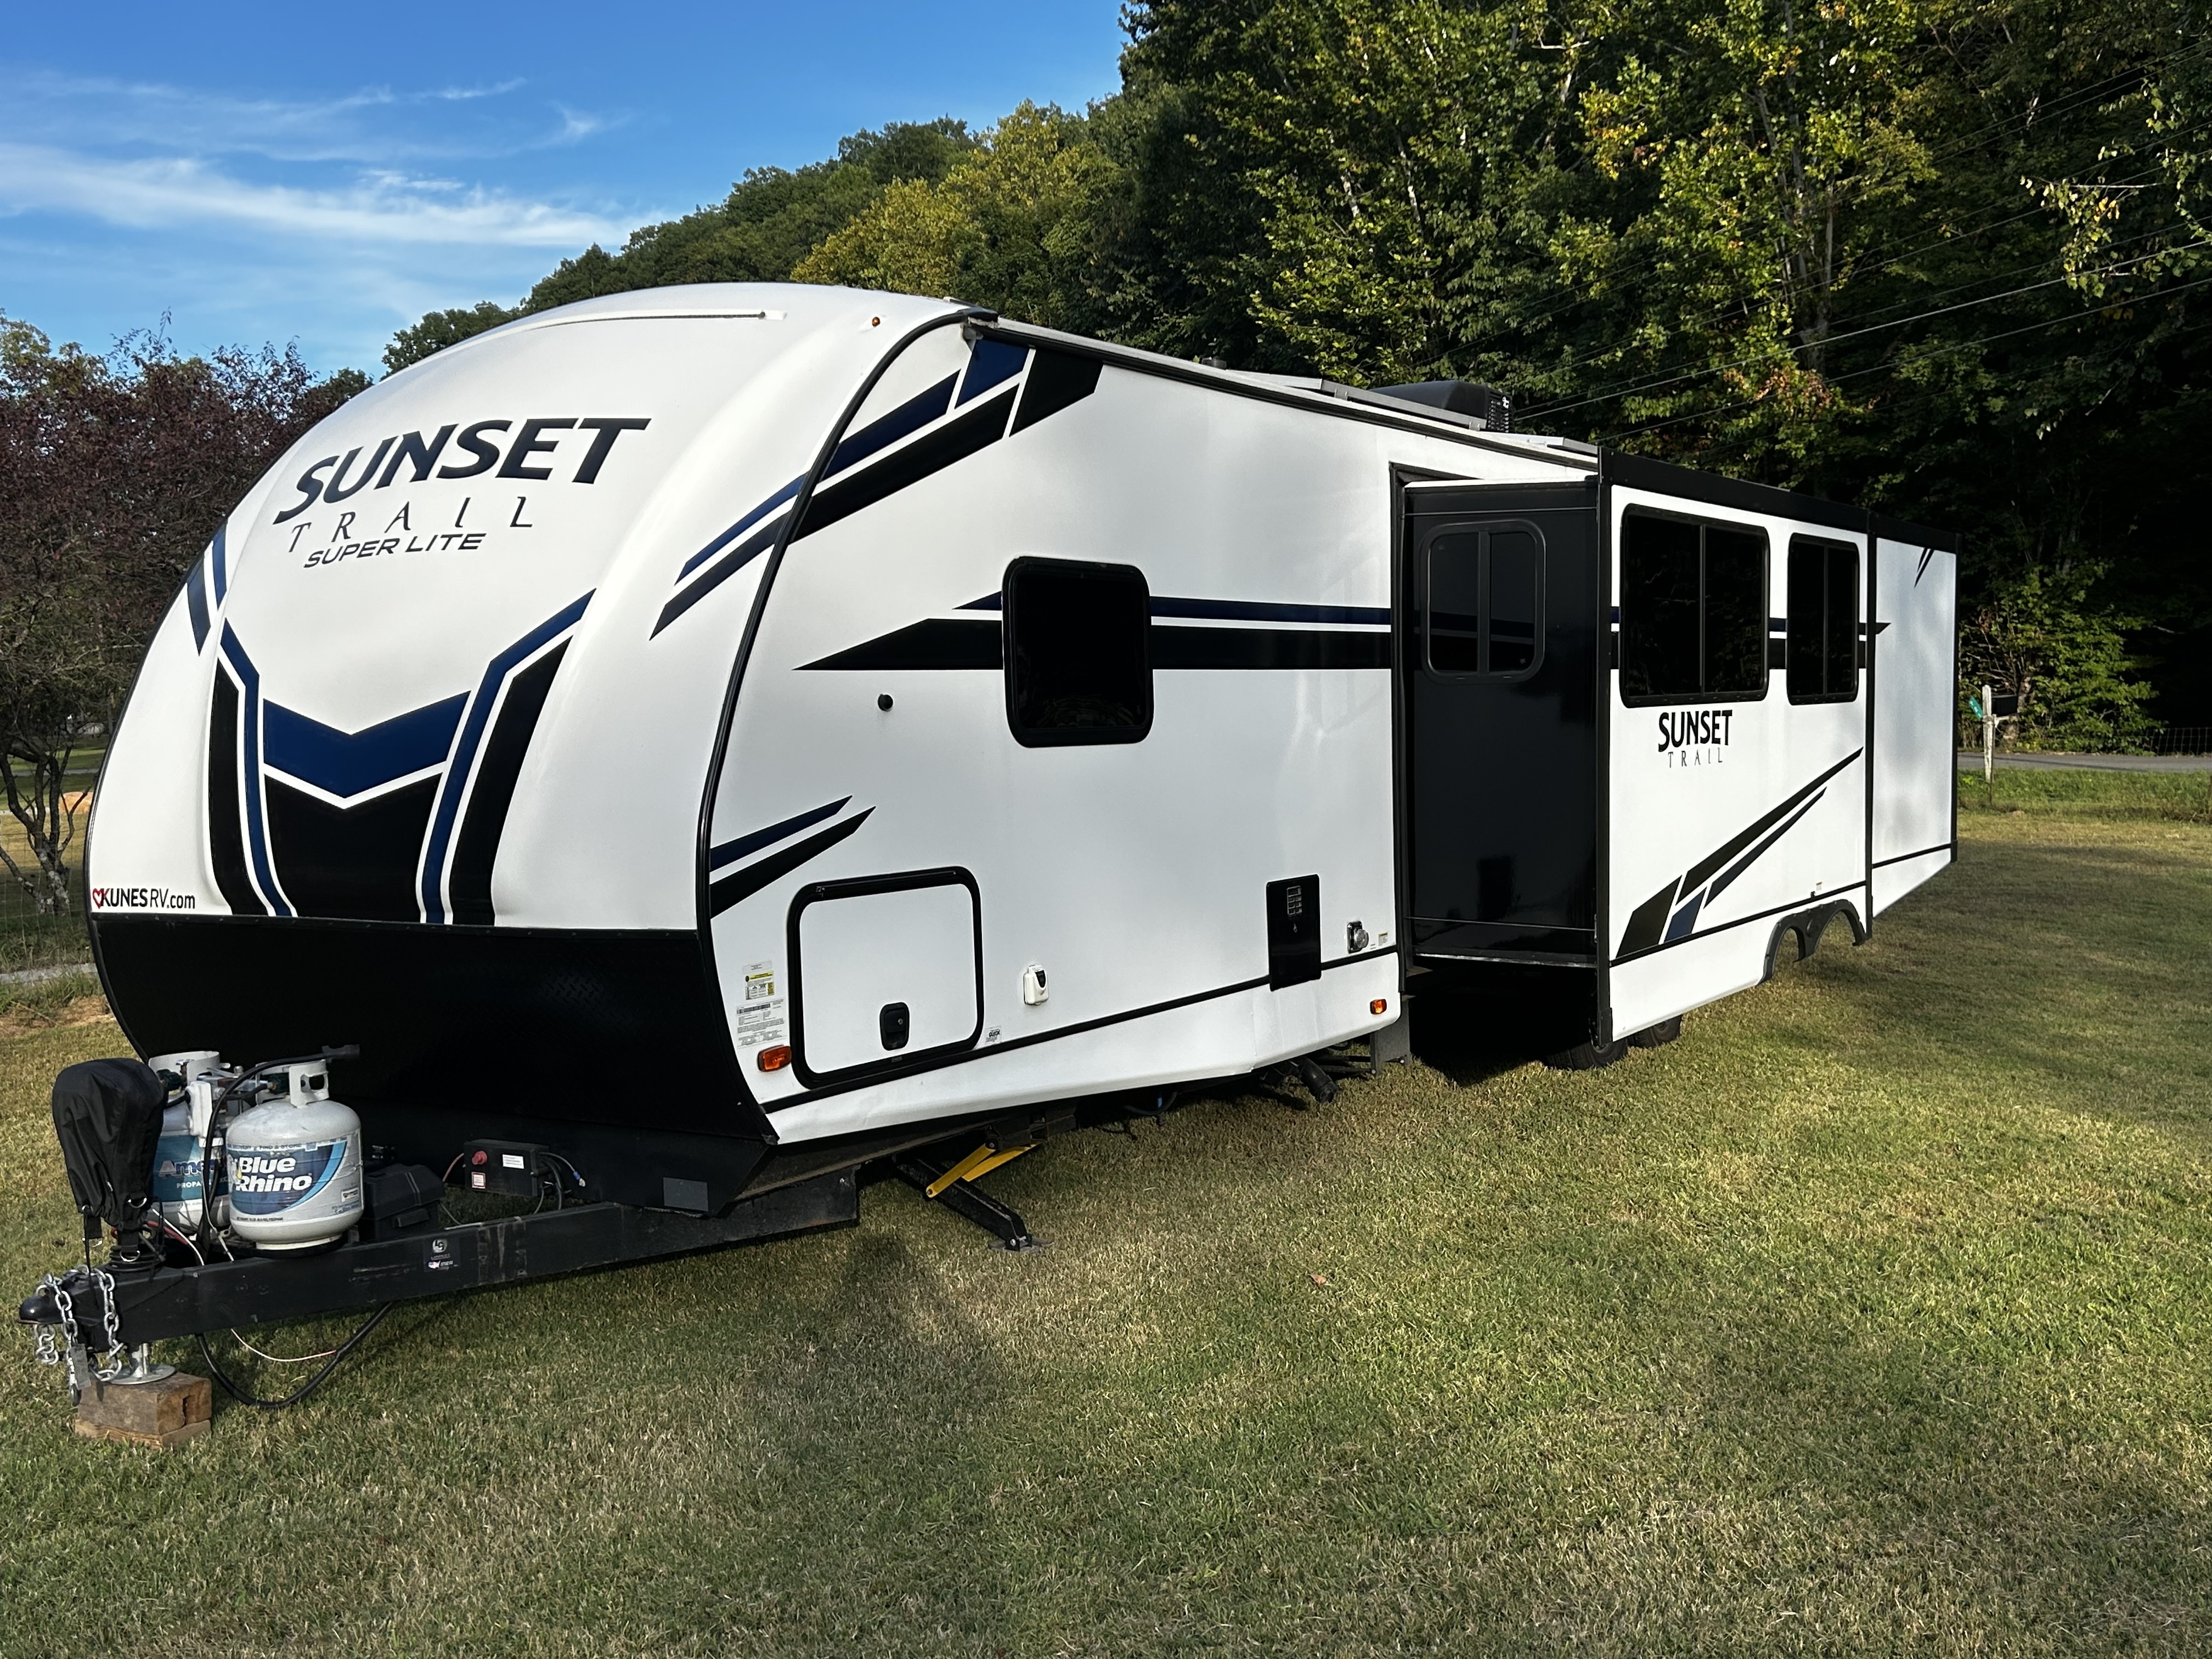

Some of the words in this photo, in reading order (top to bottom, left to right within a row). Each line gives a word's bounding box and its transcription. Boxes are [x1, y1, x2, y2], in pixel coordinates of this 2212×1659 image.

[273, 417, 652, 525] SUNSET
[288, 496, 533, 553] TRAIL
[303, 537, 400, 568] SUPER
[404, 532, 487, 553] LITE
[1658, 709, 1733, 752] SUNSET
[1668, 747, 1723, 768] TRAIL
[239, 1156, 296, 1173] Blue
[236, 1174, 312, 1192] Rhino
